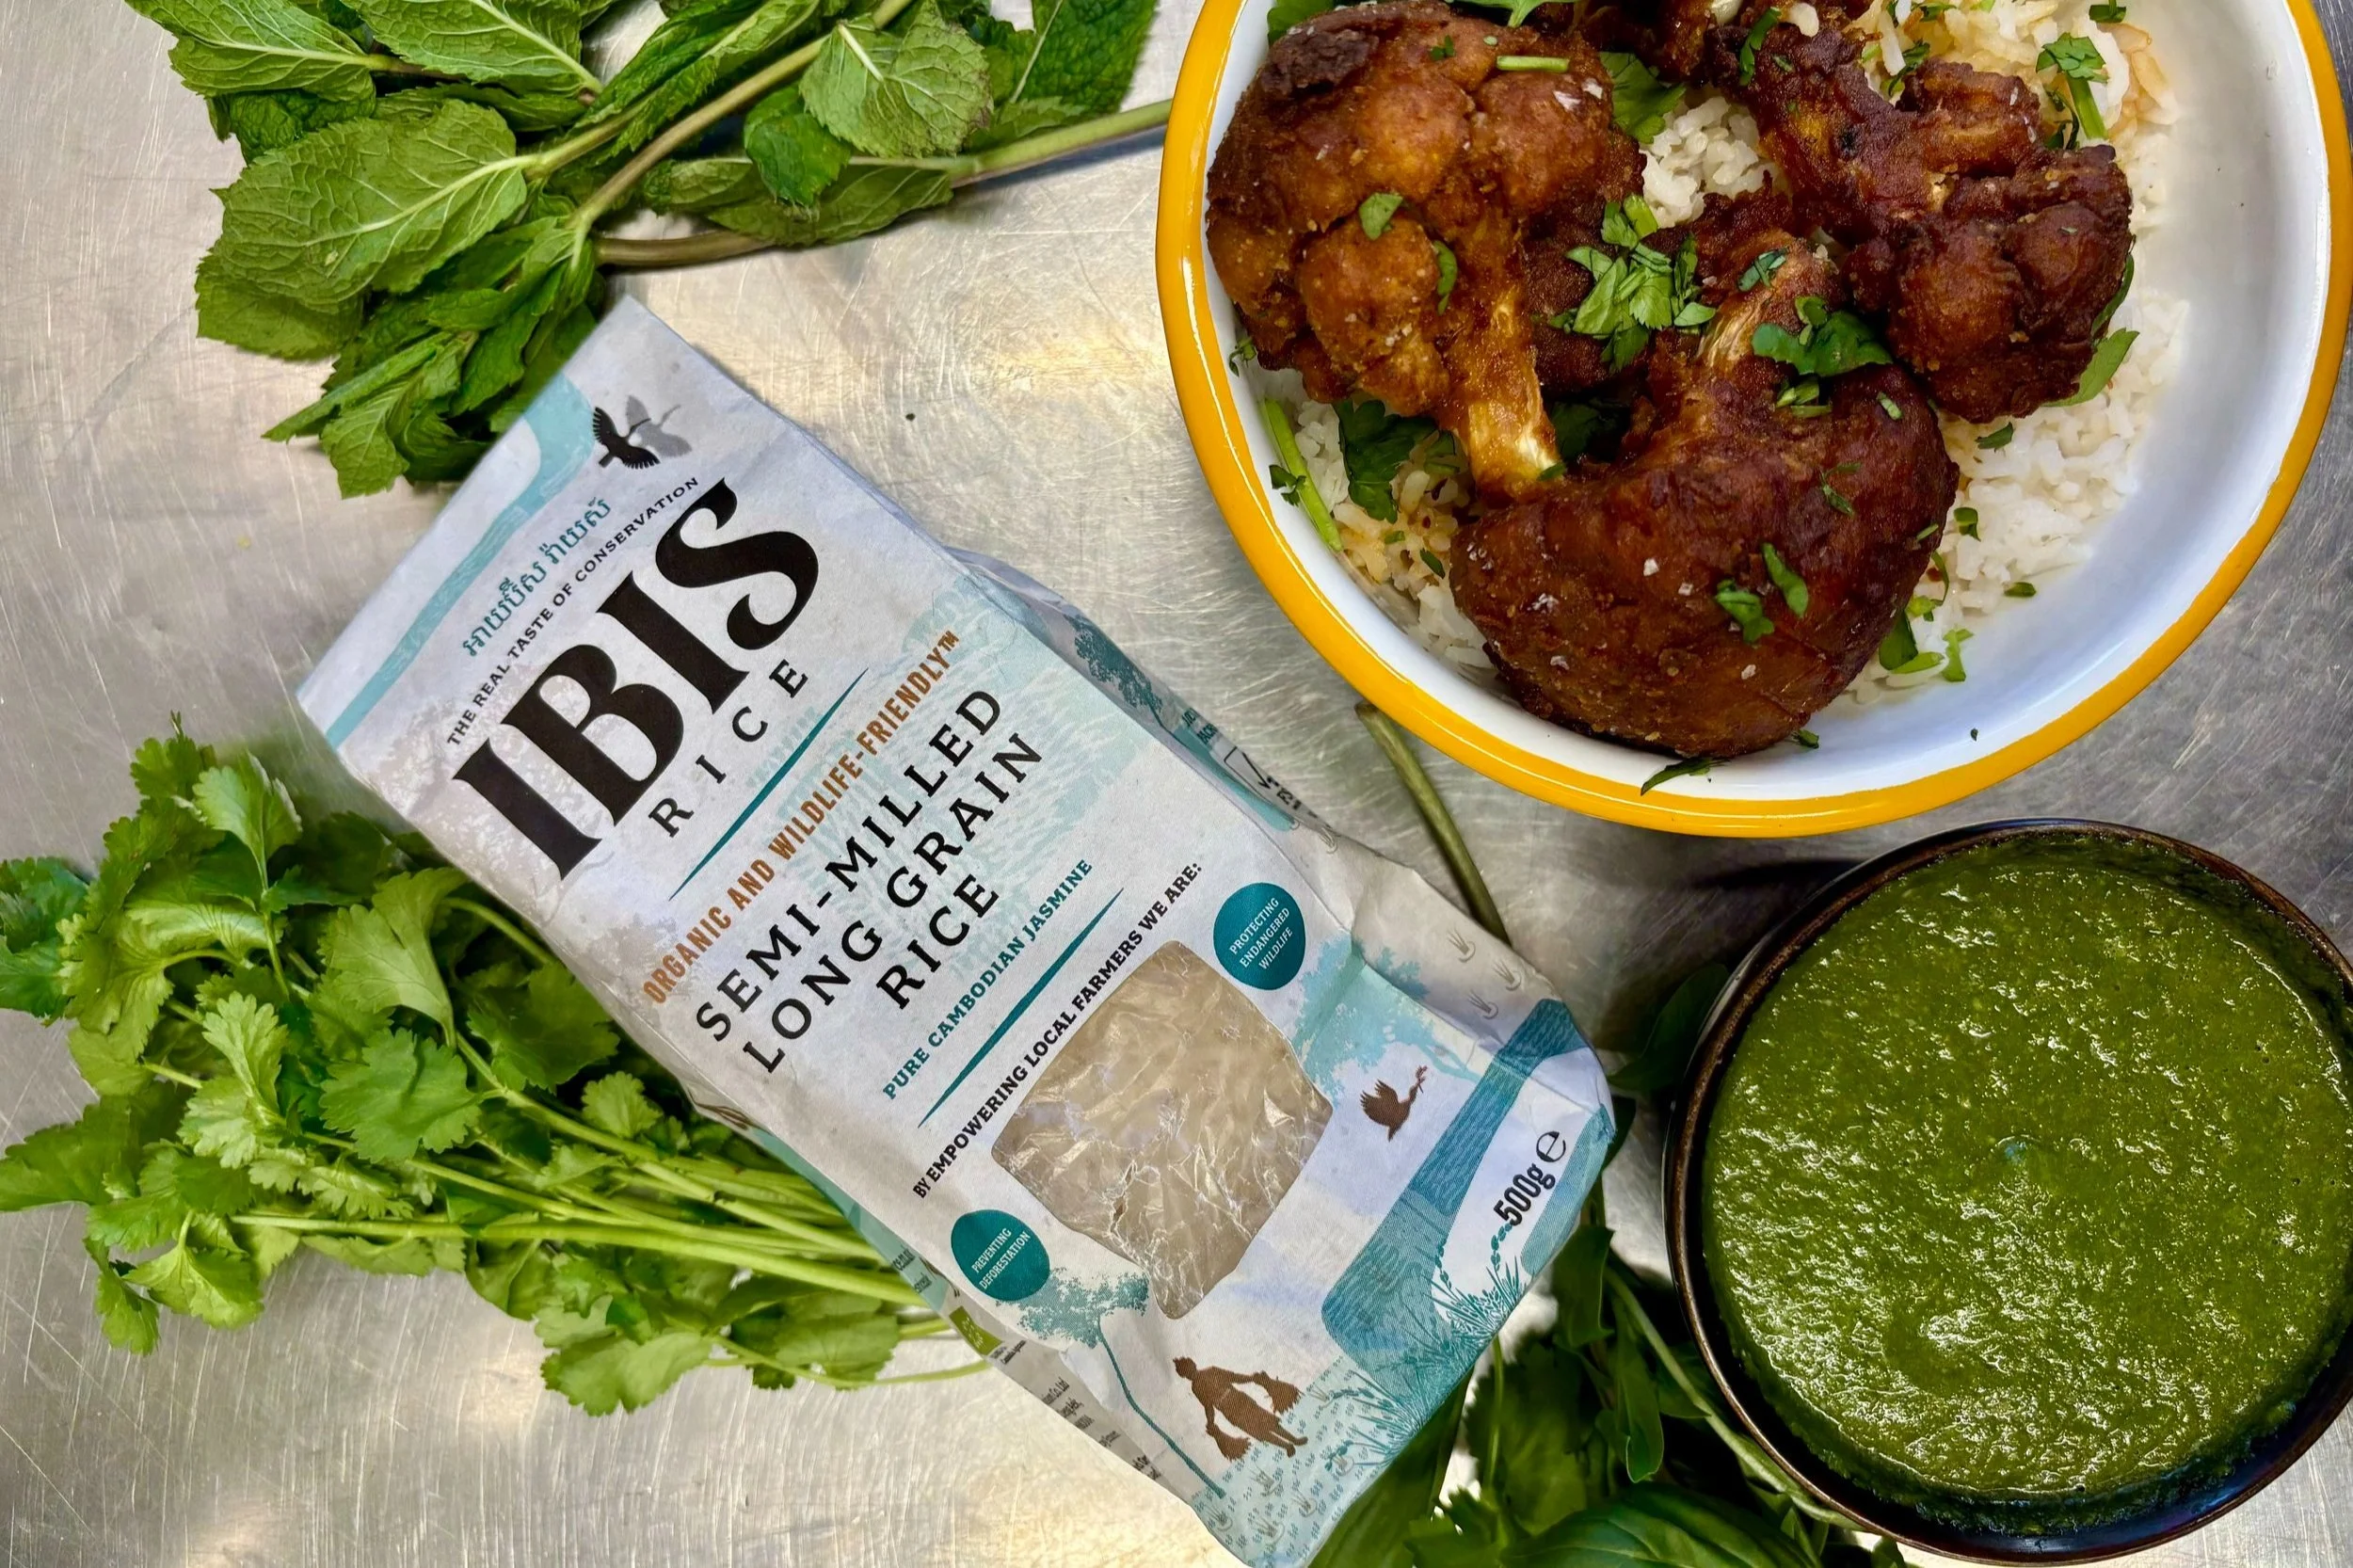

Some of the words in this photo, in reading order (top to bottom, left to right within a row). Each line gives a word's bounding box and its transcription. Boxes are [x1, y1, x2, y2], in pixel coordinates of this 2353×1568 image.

[447, 711, 476, 747] THE
[472, 664, 510, 709] REAL
[507, 607, 553, 659] TASTE
[553, 584, 573, 607] OF
[575, 476, 698, 582] CONSERVATION
[452, 477, 819, 880] IBIS
[648, 660, 808, 838] RICE
[642, 906, 732, 1004] ORGANIC
[727, 858, 776, 910] AND
[696, 690, 1000, 1042] SEMI-MILLED
[744, 920, 883, 1074] LONG
[886, 732, 1043, 908] GRAIN
[1229, 897, 1279, 955] PROTECTING
[1240, 907, 1289, 968] ENDANGERED
[876, 874, 1000, 1009] RICE
[883, 1048, 930, 1099] PURE
[928, 938, 1026, 1048] CAMBODIAN
[1022, 859, 1093, 942] JASMINE
[1258, 926, 1292, 969] WILDLIFE
[912, 1176, 933, 1198] BY
[926, 1064, 1028, 1184] EMPOWERING
[1024, 1007, 1076, 1068] LOCAL
[1072, 930, 1144, 1014] FARMERS
[1138, 900, 1168, 934] WE
[1165, 863, 1203, 904] ARE:
[971, 1227, 1012, 1273] PREVENTING
[979, 1230, 1031, 1289] DEFORESTATION
[1493, 1162, 1556, 1226] 500g
